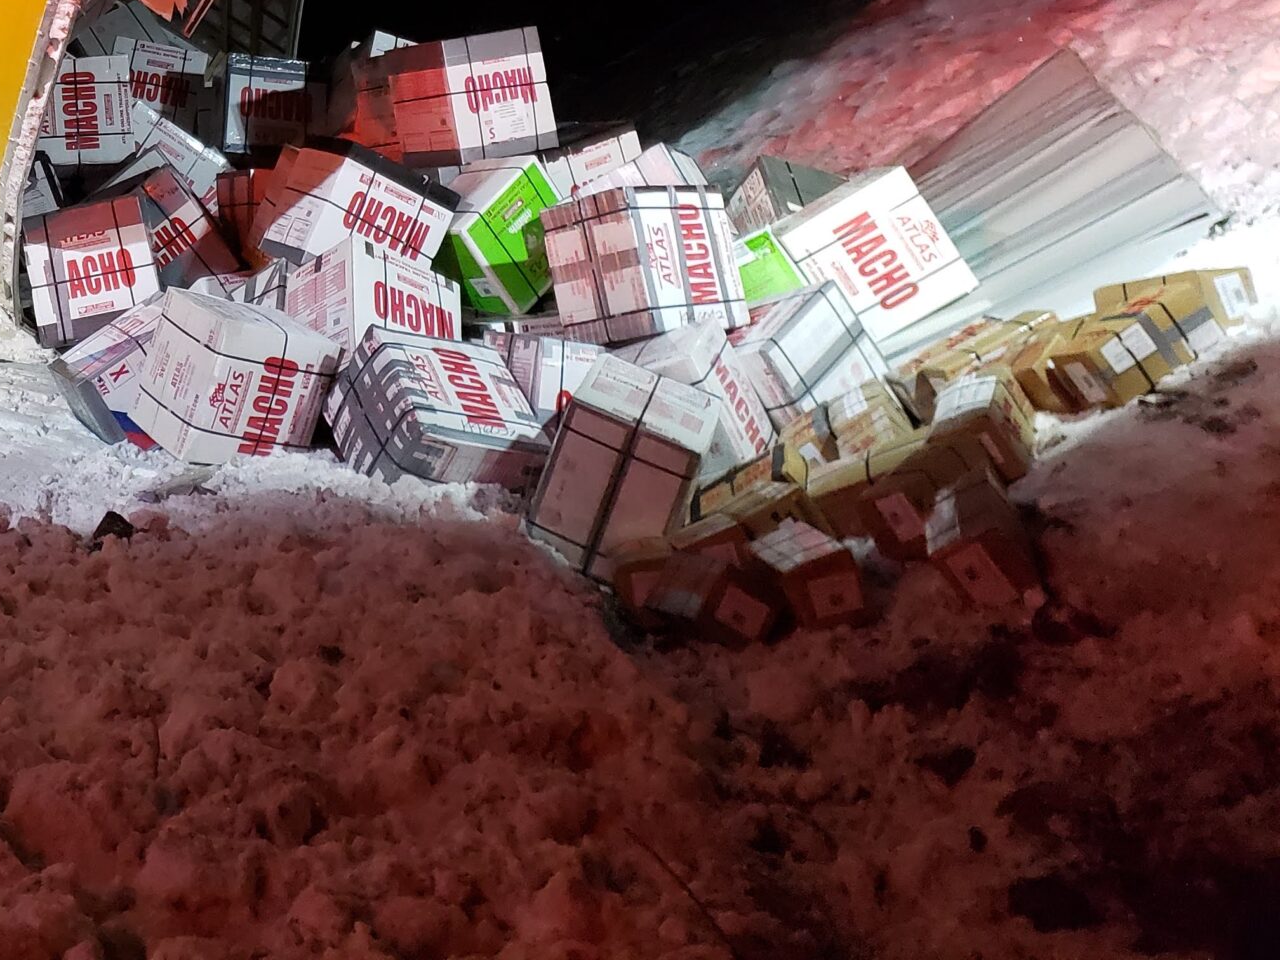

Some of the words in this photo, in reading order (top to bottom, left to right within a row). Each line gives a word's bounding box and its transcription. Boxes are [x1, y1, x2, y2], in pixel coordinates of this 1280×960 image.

[60, 71, 100, 151] MACHO
[464, 66, 538, 114] MACHO
[342, 190, 431, 262] MACHO
[652, 226, 675, 285] ATLAS
[677, 203, 720, 304] MACHO
[896, 215, 938, 263] ATLAS
[67, 248, 136, 299] ACHO
[832, 210, 920, 310] MACHO
[373, 280, 455, 340] MACHO
[219, 370, 246, 430] ATLAS
[237, 356, 300, 457] MACHO
[408, 353, 446, 401] ATLAS
[432, 347, 507, 429] MACHO
